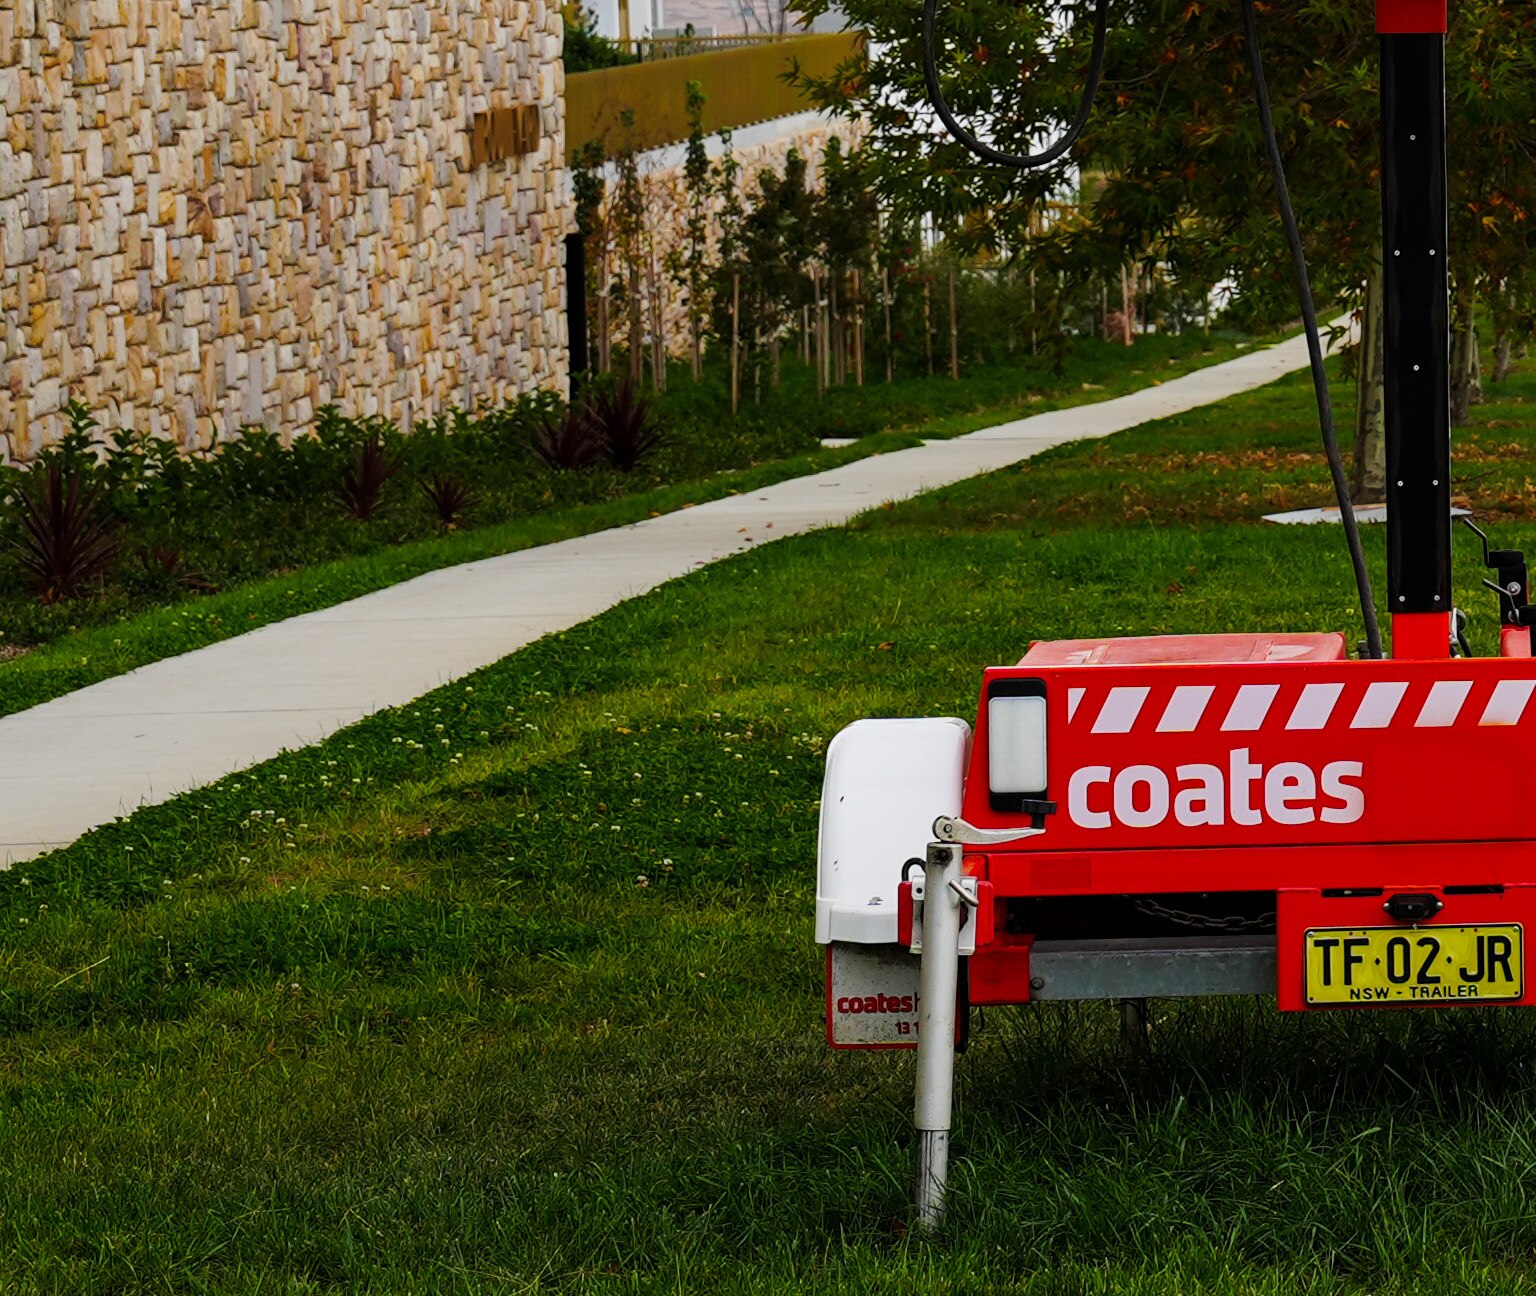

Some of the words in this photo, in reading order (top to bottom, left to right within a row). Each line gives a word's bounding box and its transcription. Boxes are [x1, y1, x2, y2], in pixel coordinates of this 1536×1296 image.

[1068, 747, 1365, 829] coates
[1350, 987, 1390, 1000] NSW
[1409, 985, 1478, 999] TRAILER
[895, 1021, 911, 1035] 13
